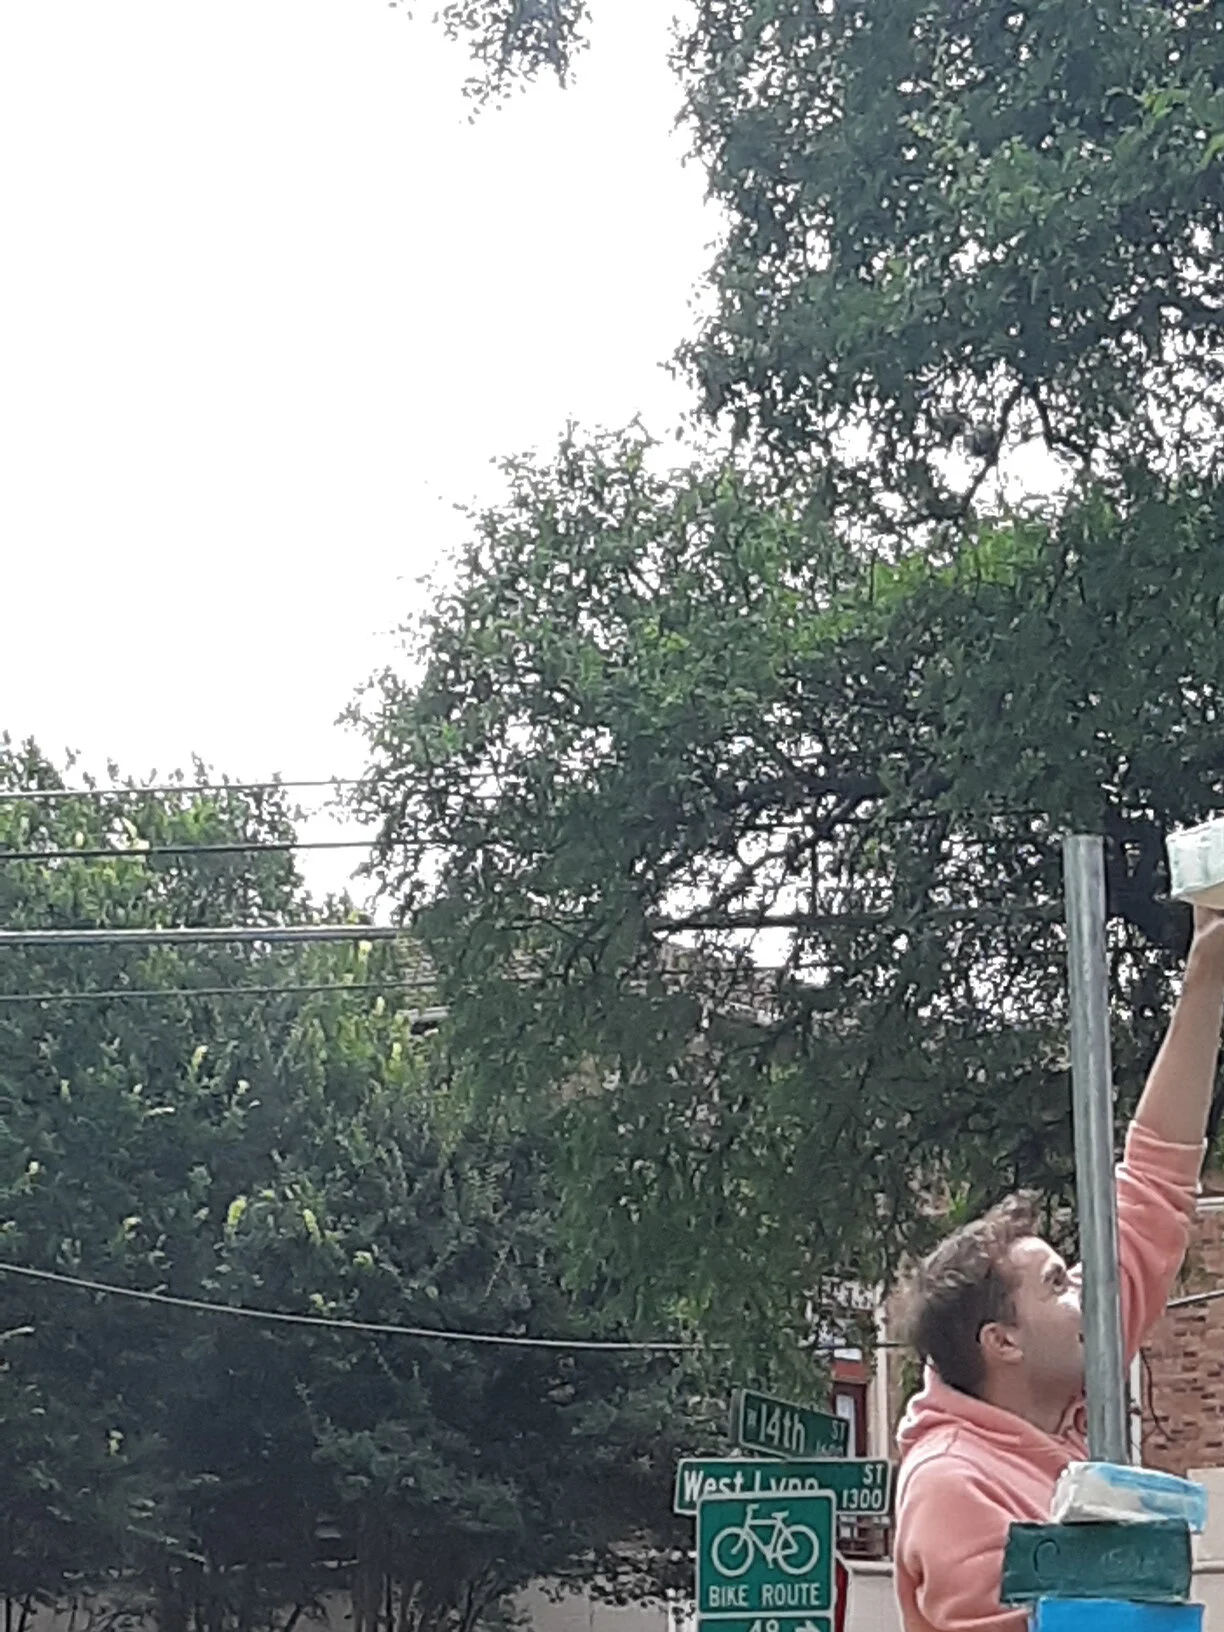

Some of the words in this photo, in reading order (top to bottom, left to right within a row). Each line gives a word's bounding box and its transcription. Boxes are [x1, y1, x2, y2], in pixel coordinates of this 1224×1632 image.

[760, 1404, 806, 1454] 14th
[830, 1419, 847, 1441] ST
[684, 1470, 744, 1502] West
[863, 1464, 884, 1485] ST
[841, 1488, 882, 1509] 1300
[709, 1585, 749, 1607] BIKE
[761, 1582, 820, 1606] ROUTE
